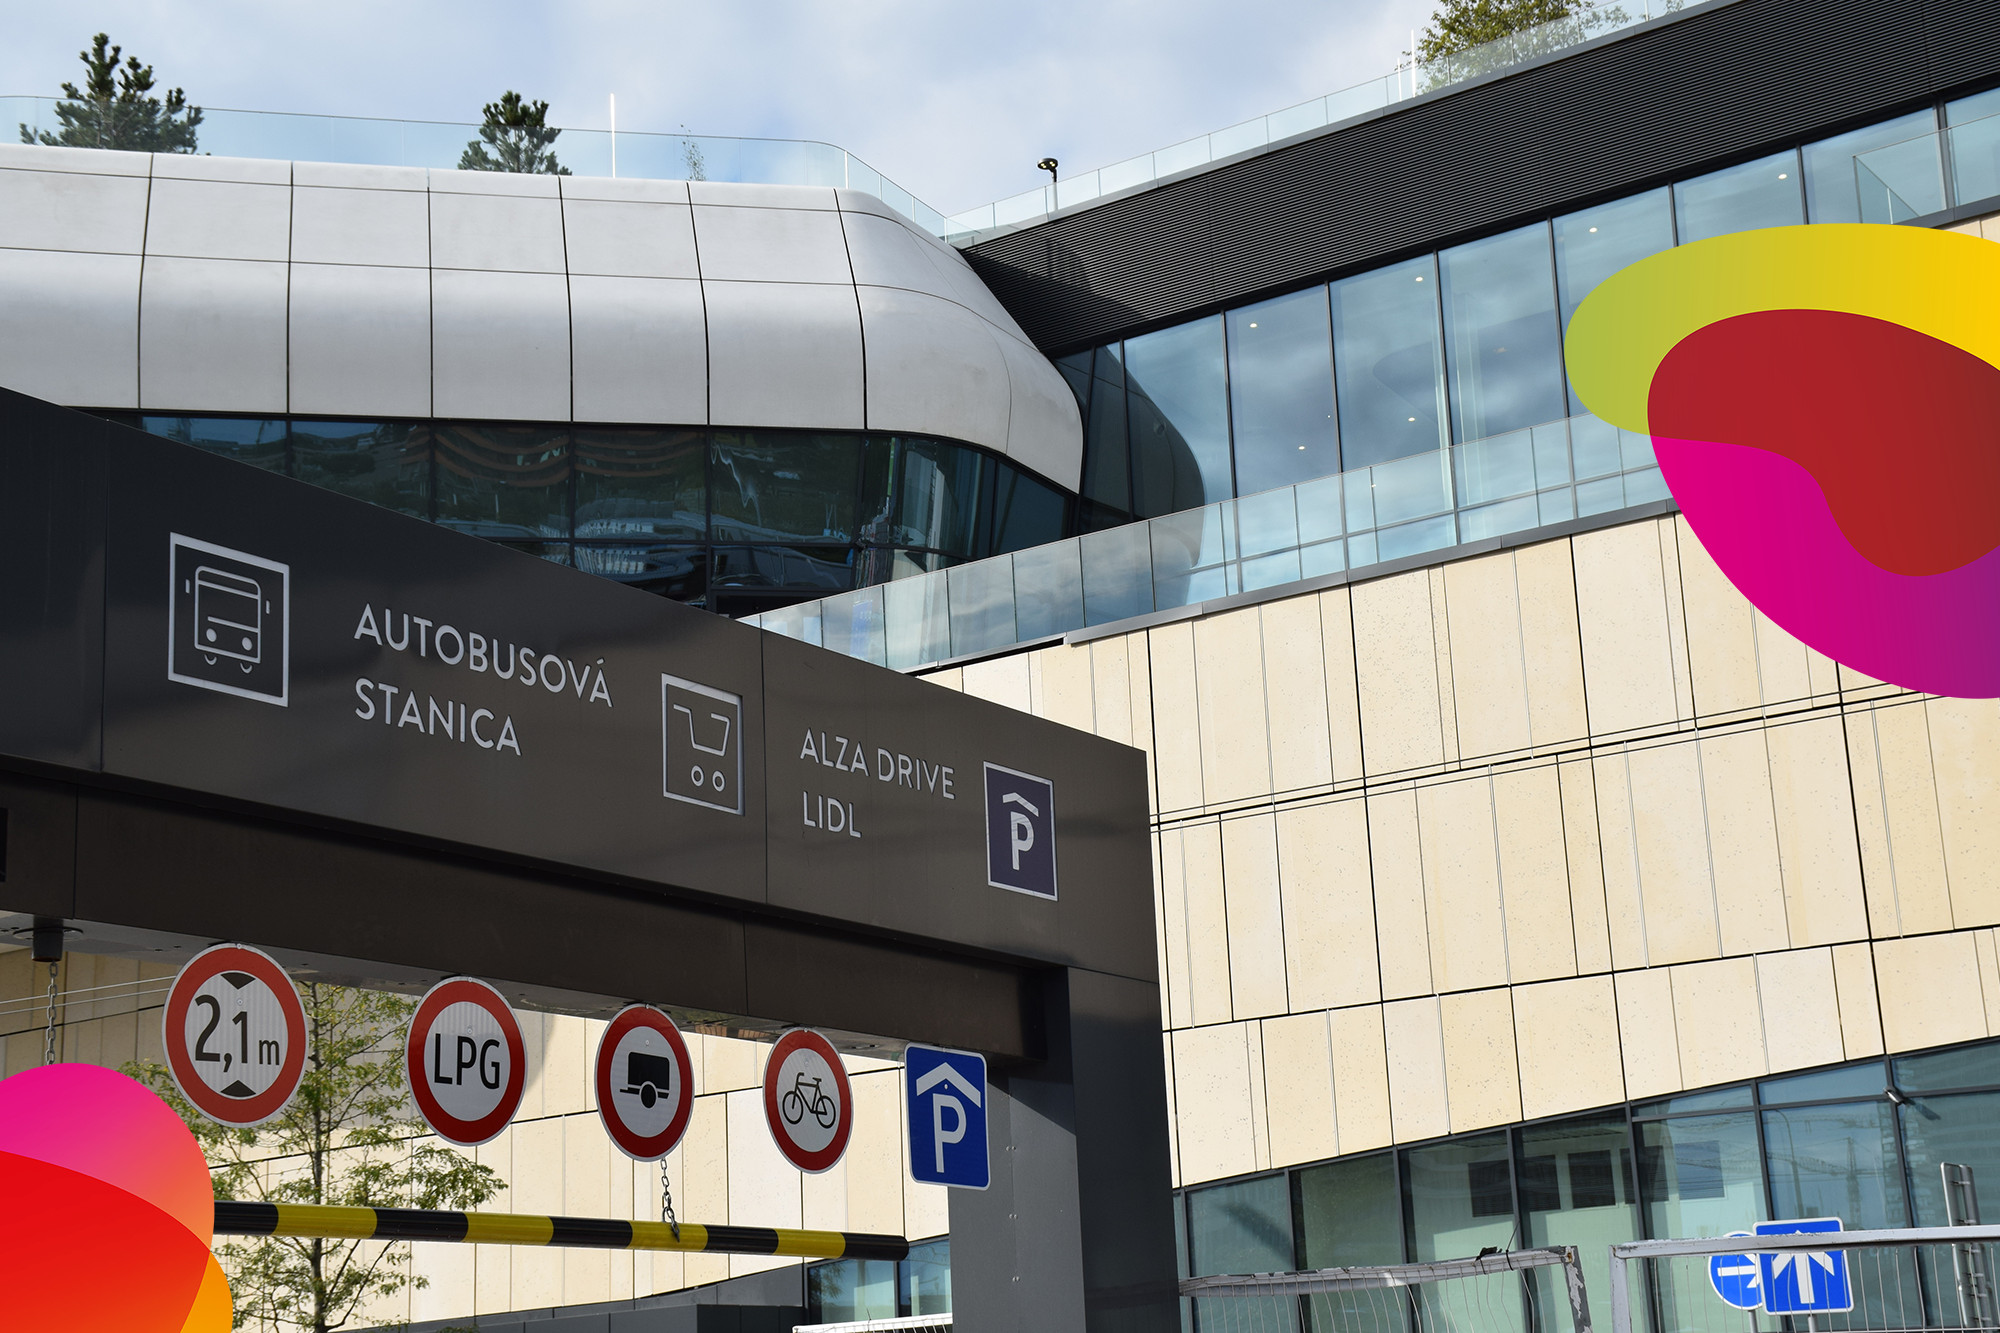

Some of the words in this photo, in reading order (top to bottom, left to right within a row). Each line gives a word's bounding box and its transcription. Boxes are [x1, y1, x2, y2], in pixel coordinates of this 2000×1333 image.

[354, 602, 614, 708] AUTOBUSOVÁ
[355, 678, 522, 756] STANICA
[800, 728, 871, 777] ALZA
[878, 747, 956, 800] DRIVE
[803, 791, 861, 839] LIDL
[1010, 811, 1034, 871] P
[433, 1033, 501, 1090] LPG
[932, 1093, 967, 1174] P
